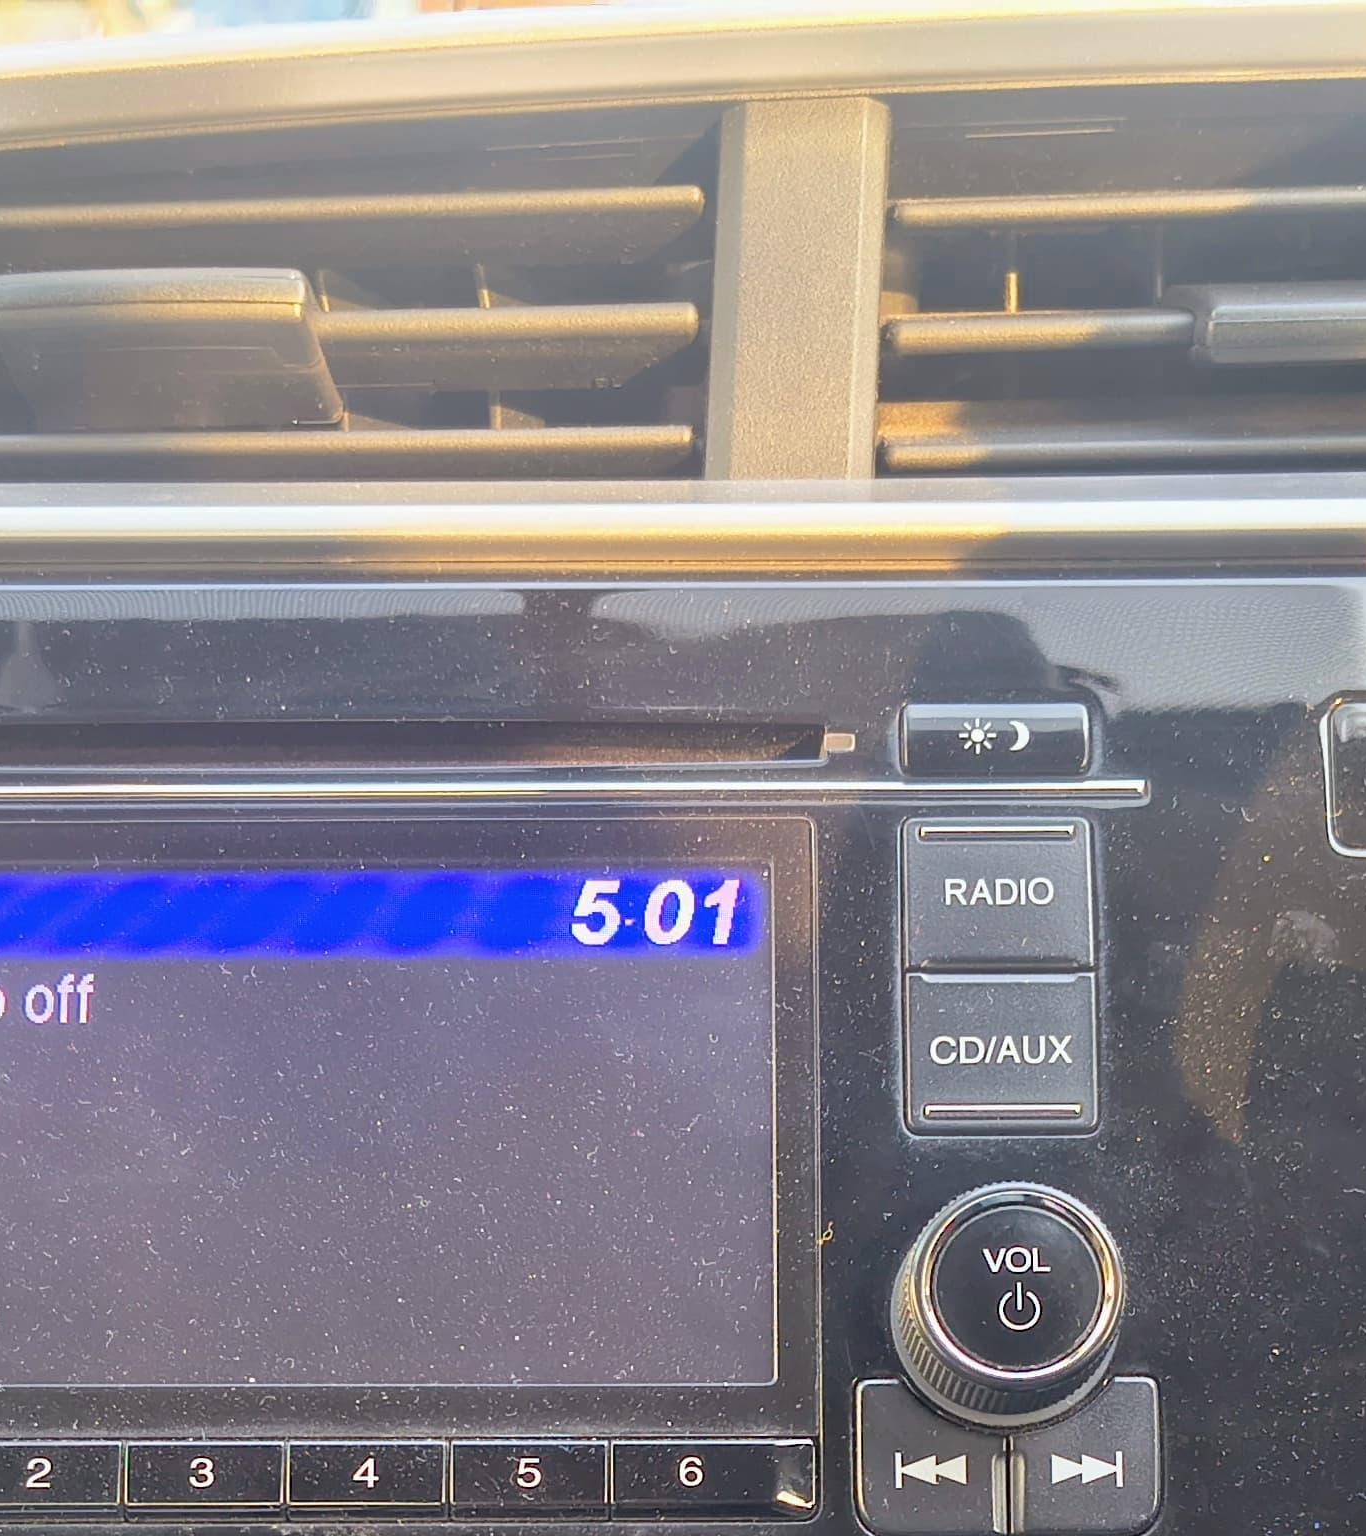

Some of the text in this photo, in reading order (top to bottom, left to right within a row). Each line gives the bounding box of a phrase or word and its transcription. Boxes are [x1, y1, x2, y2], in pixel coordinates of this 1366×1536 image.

[944, 877, 1055, 906] RADIO
[24, 973, 95, 1024] off
[929, 1034, 1073, 1065] CD/AUX
[982, 1246, 1051, 1273] VOL
[25, 1457, 52, 1488] 2
[189, 1457, 214, 1488] 3
[352, 1457, 380, 1488] 4
[516, 1457, 542, 1488] 5
[679, 1456, 703, 1487] 6
